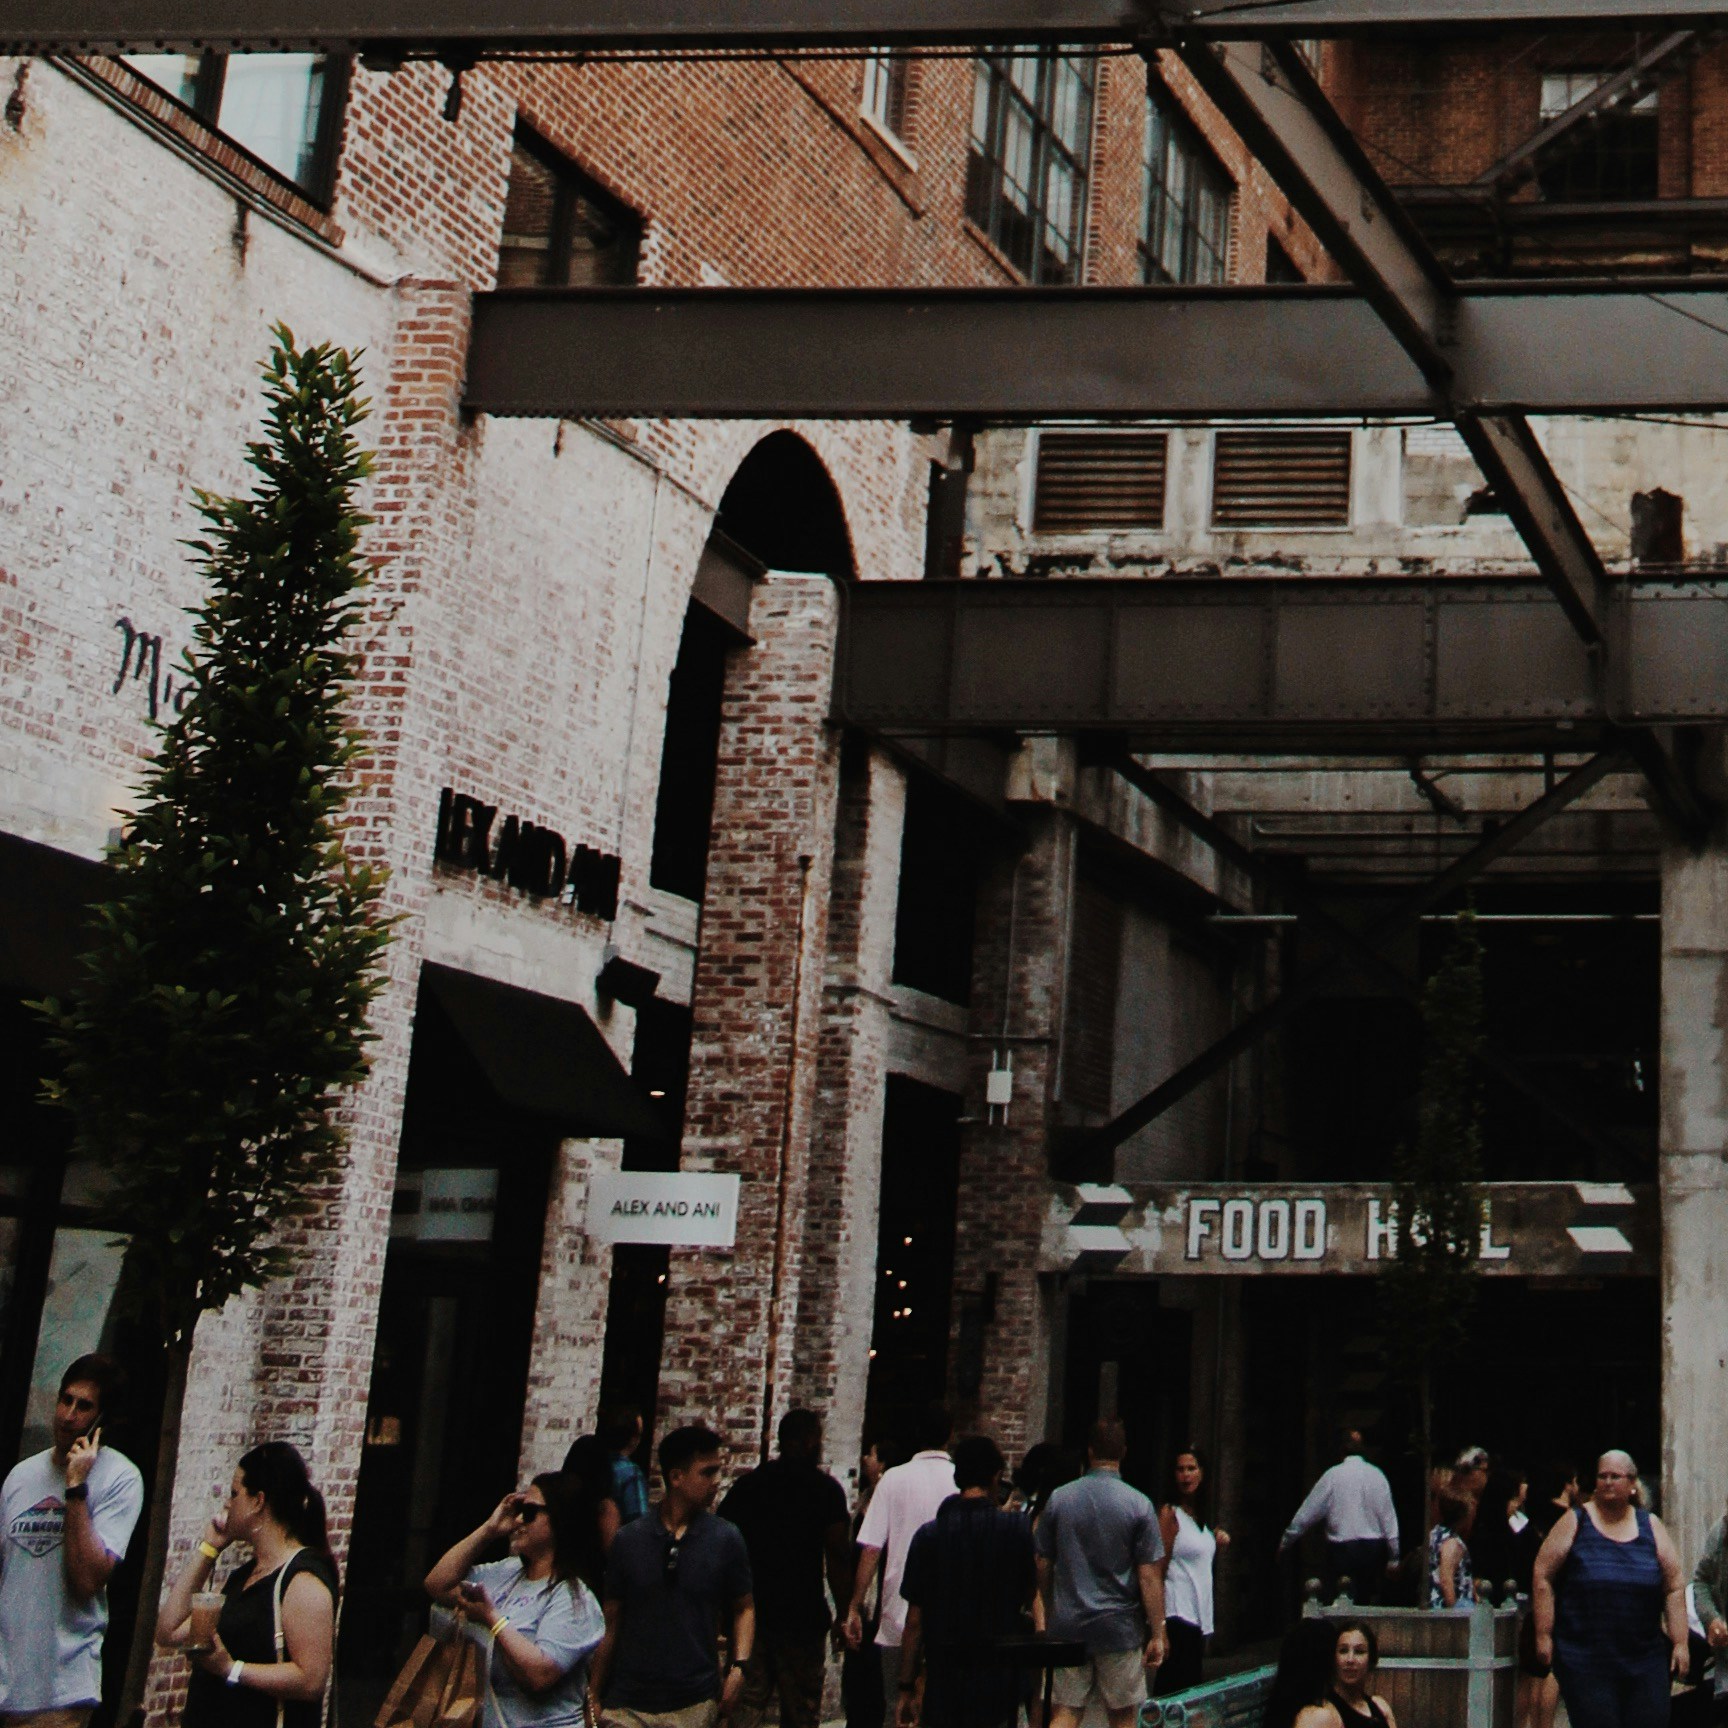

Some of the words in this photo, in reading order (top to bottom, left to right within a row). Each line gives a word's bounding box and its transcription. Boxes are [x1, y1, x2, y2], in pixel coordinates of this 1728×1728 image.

[610, 1199, 652, 1217] ALEX
[654, 1200, 689, 1218] AND
[692, 1201, 720, 1218] ANI
[1186, 1199, 1328, 1261] FOOD
[1366, 1199, 1512, 1261] HL
